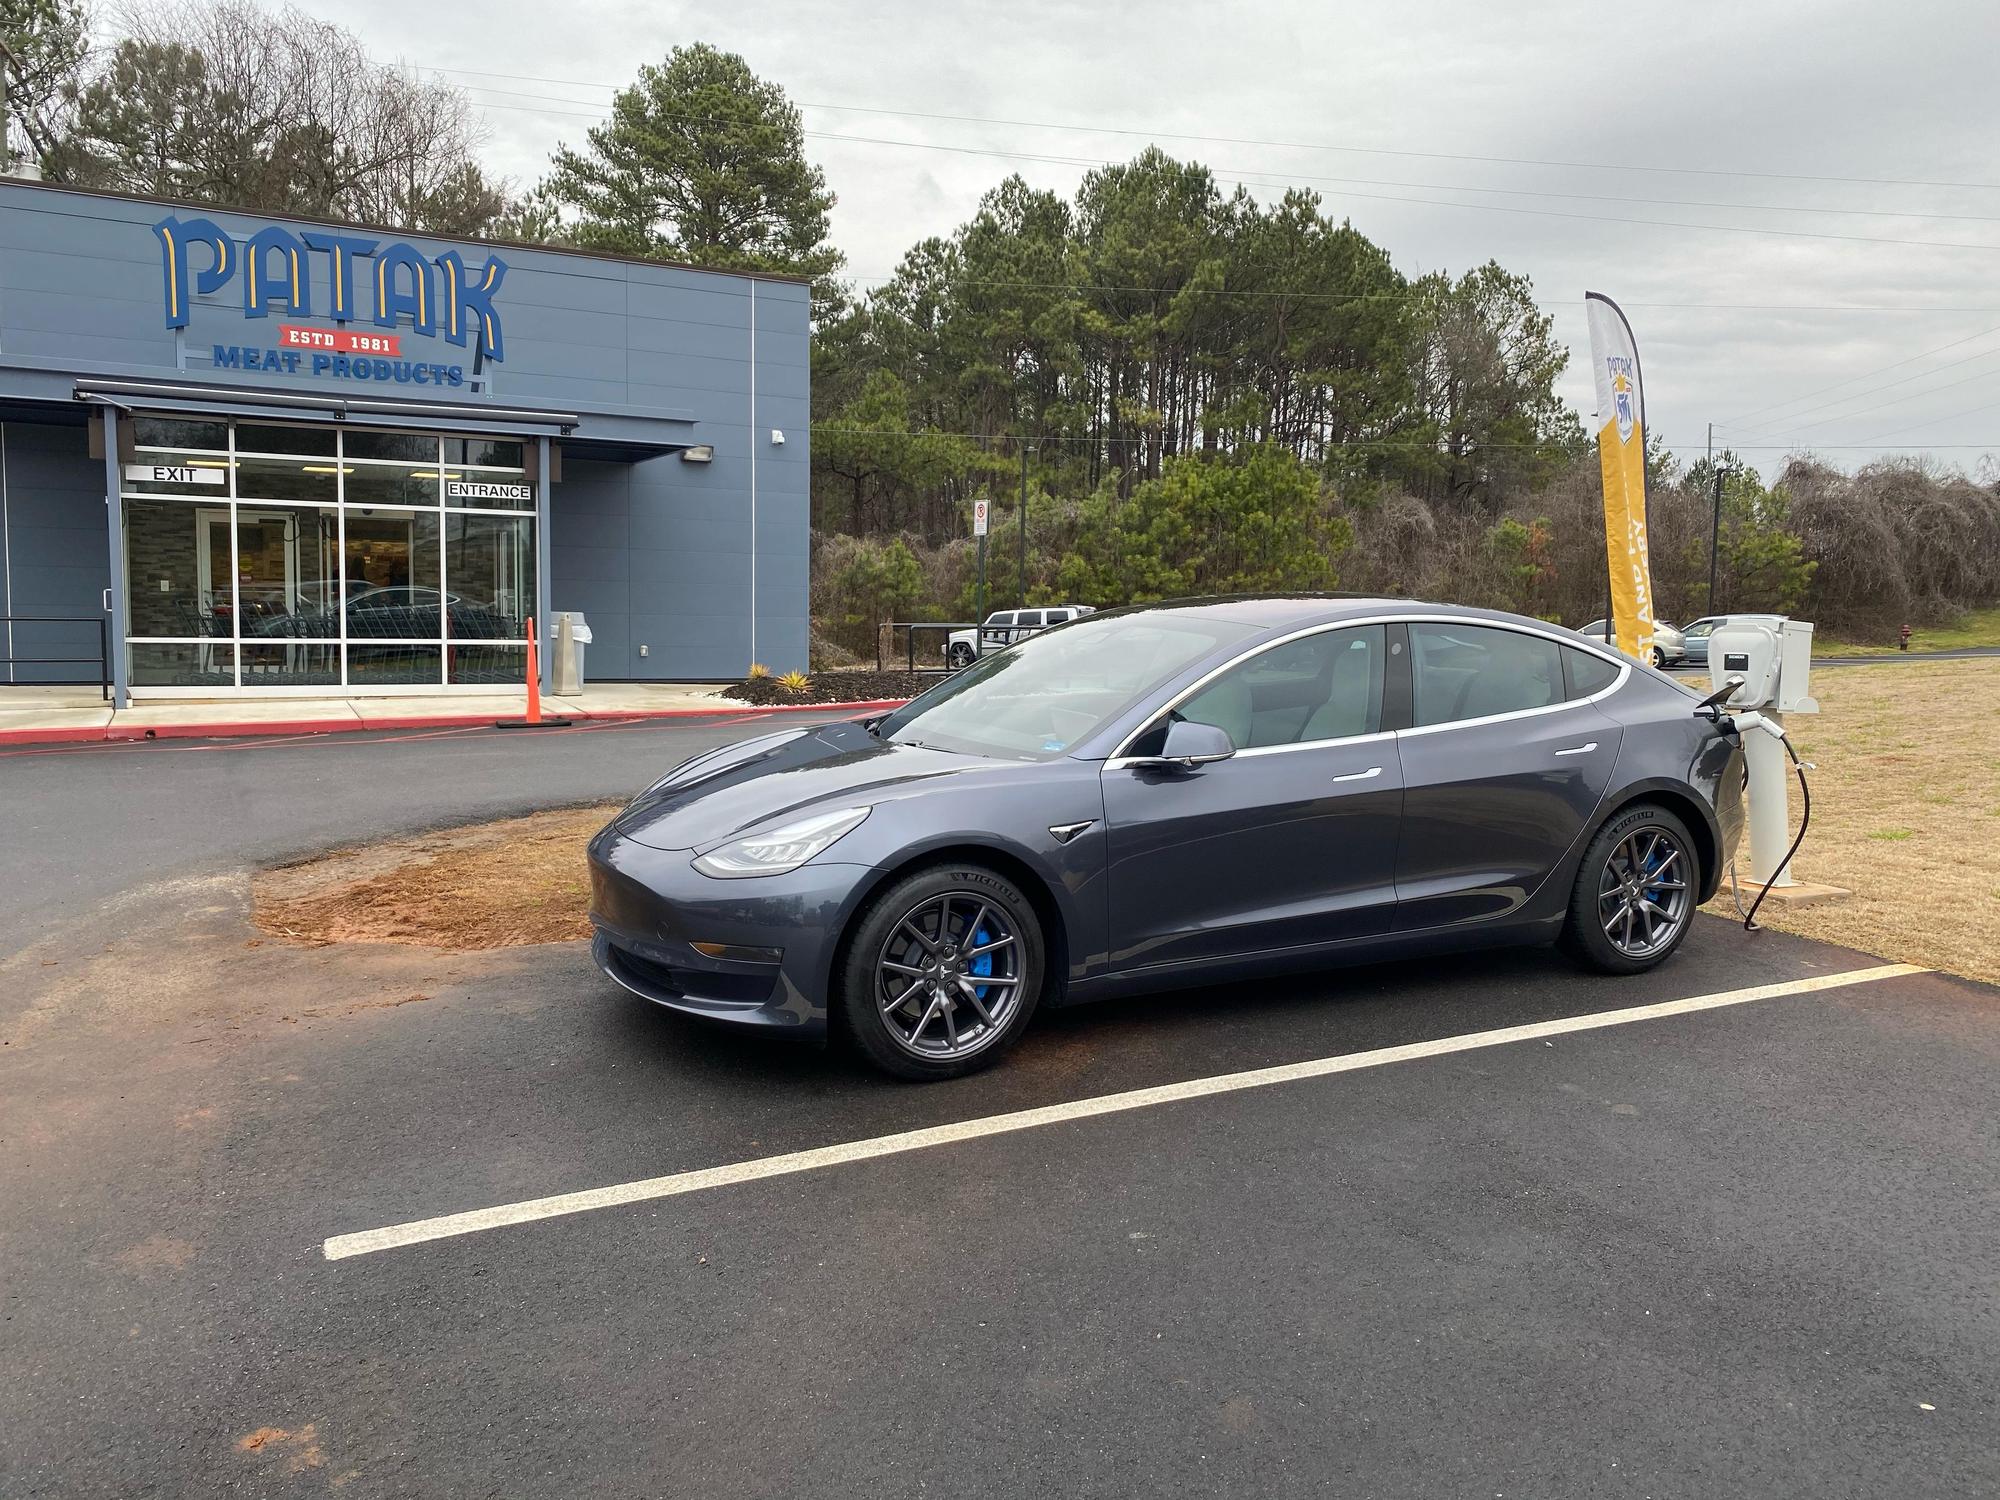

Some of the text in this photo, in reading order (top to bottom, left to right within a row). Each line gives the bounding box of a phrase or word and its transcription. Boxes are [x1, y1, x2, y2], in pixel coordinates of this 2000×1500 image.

[152, 216, 508, 363] PATAK
[289, 330, 390, 352] ESTD 1981
[213, 344, 464, 387] MEAT PRODUCTS
[1606, 356, 1633, 380] PATAK
[153, 466, 197, 482] EXIT
[449, 483, 530, 498] ENTRANCE
[1633, 564, 1651, 624] AND
[966, 872, 1020, 904] MICHELIN
